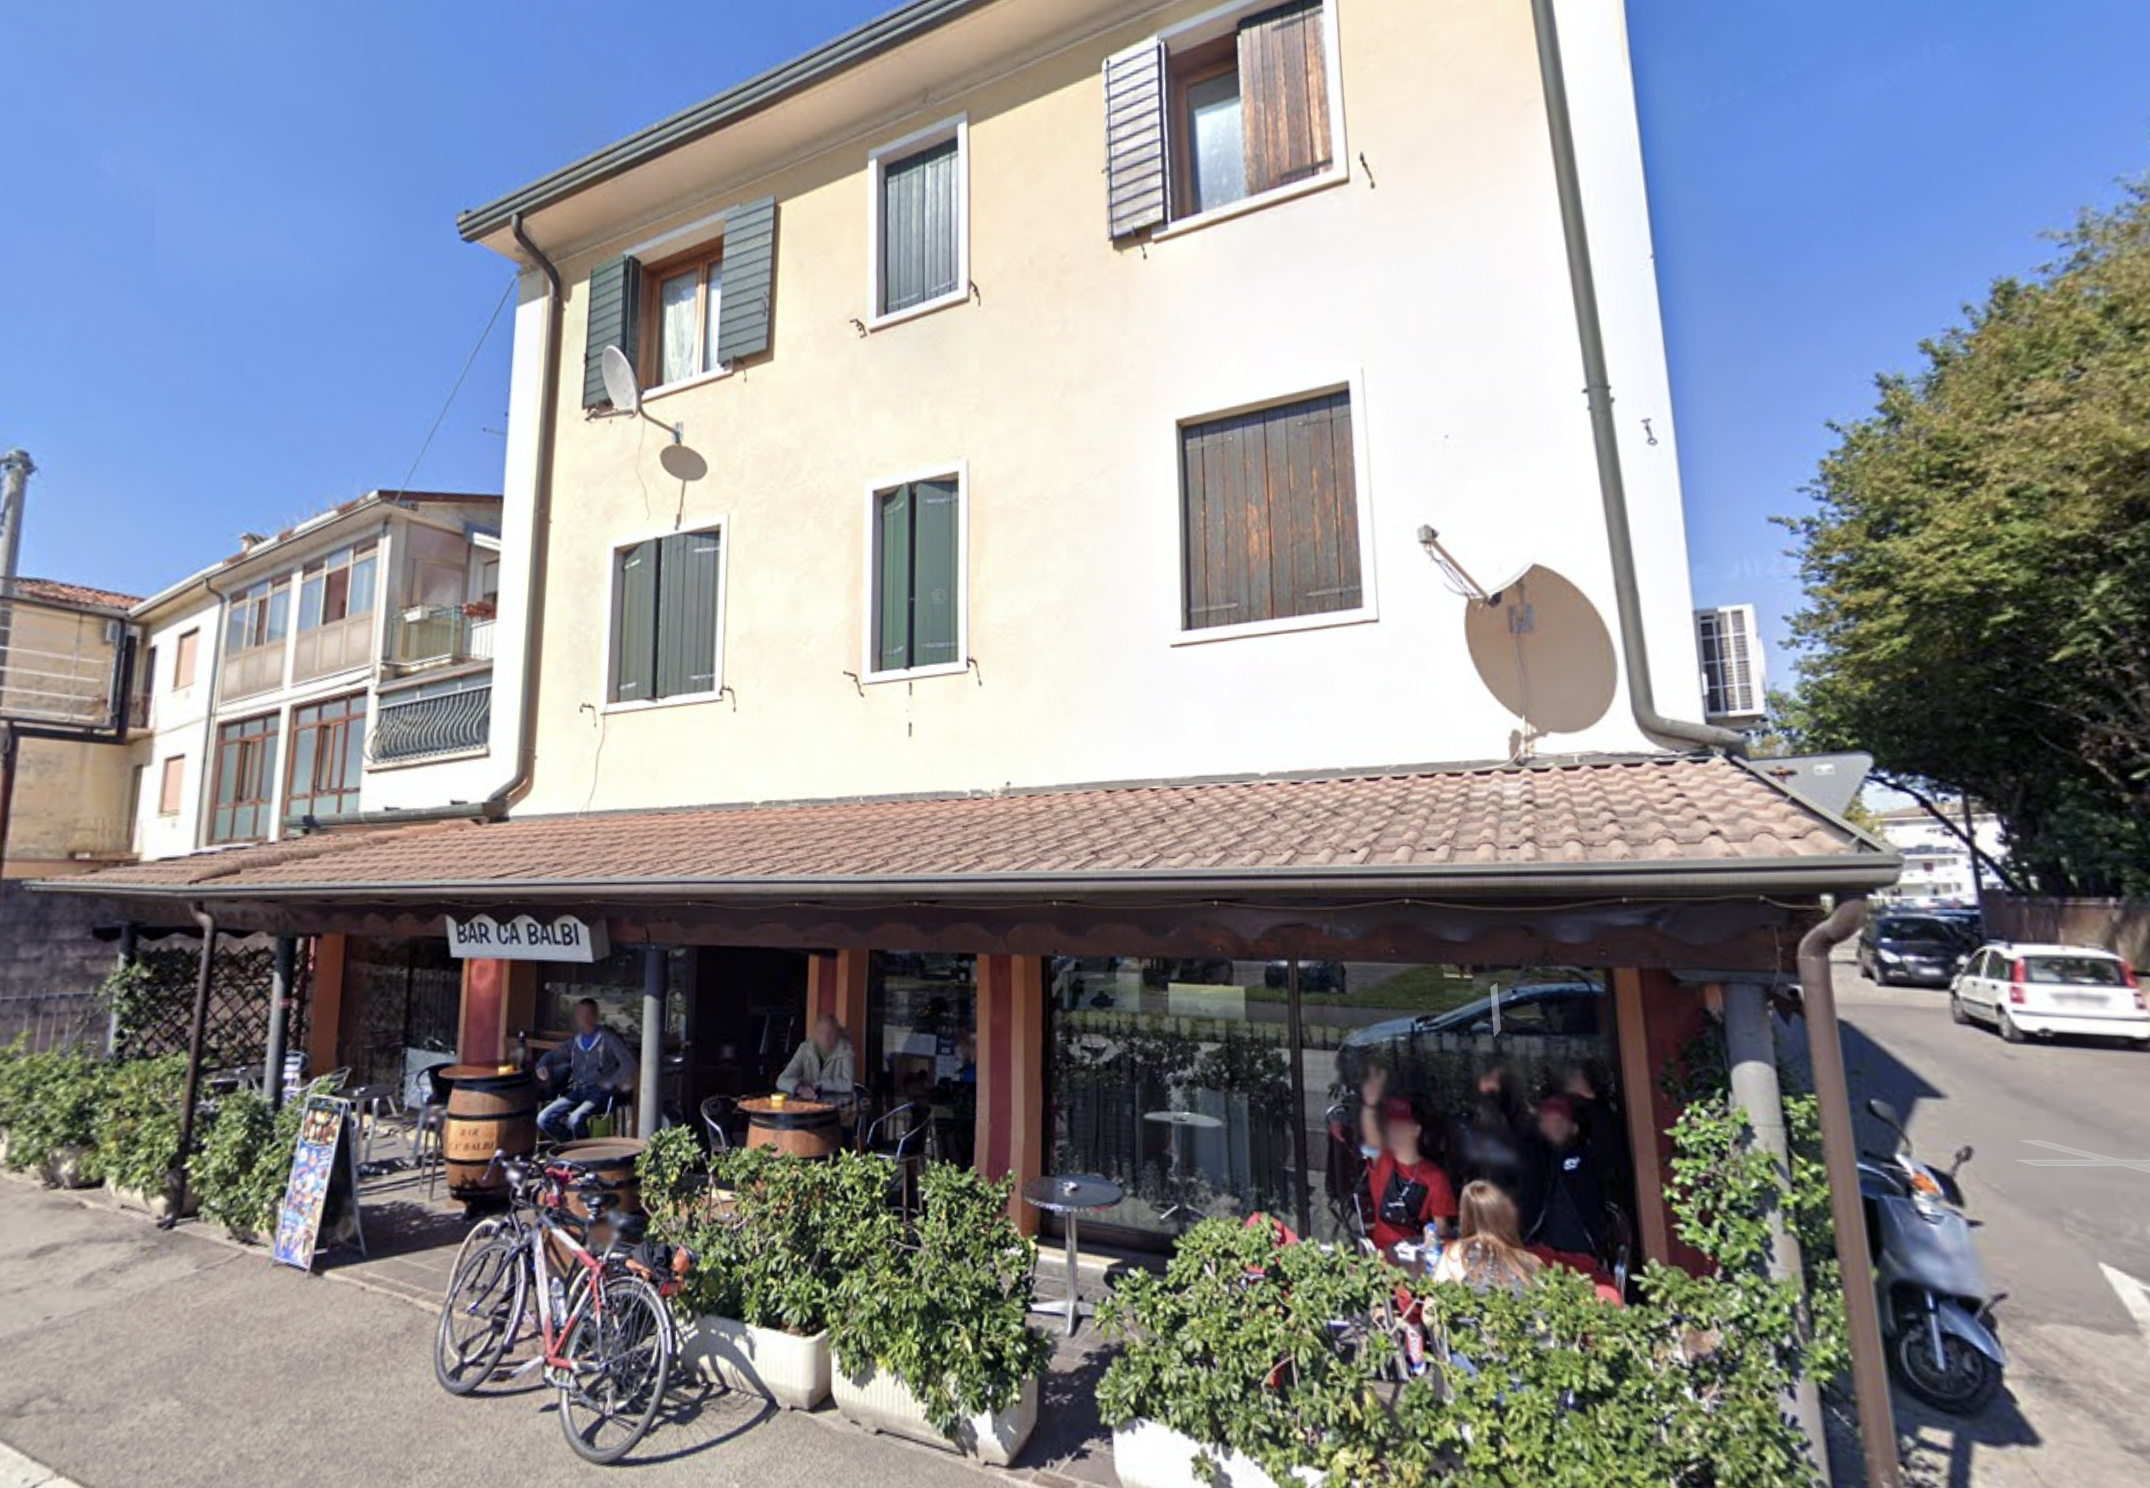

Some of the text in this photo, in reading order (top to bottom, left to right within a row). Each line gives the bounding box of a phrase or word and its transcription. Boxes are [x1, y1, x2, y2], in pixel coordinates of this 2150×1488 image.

[456, 922, 580, 946] BAR CA BALBI
